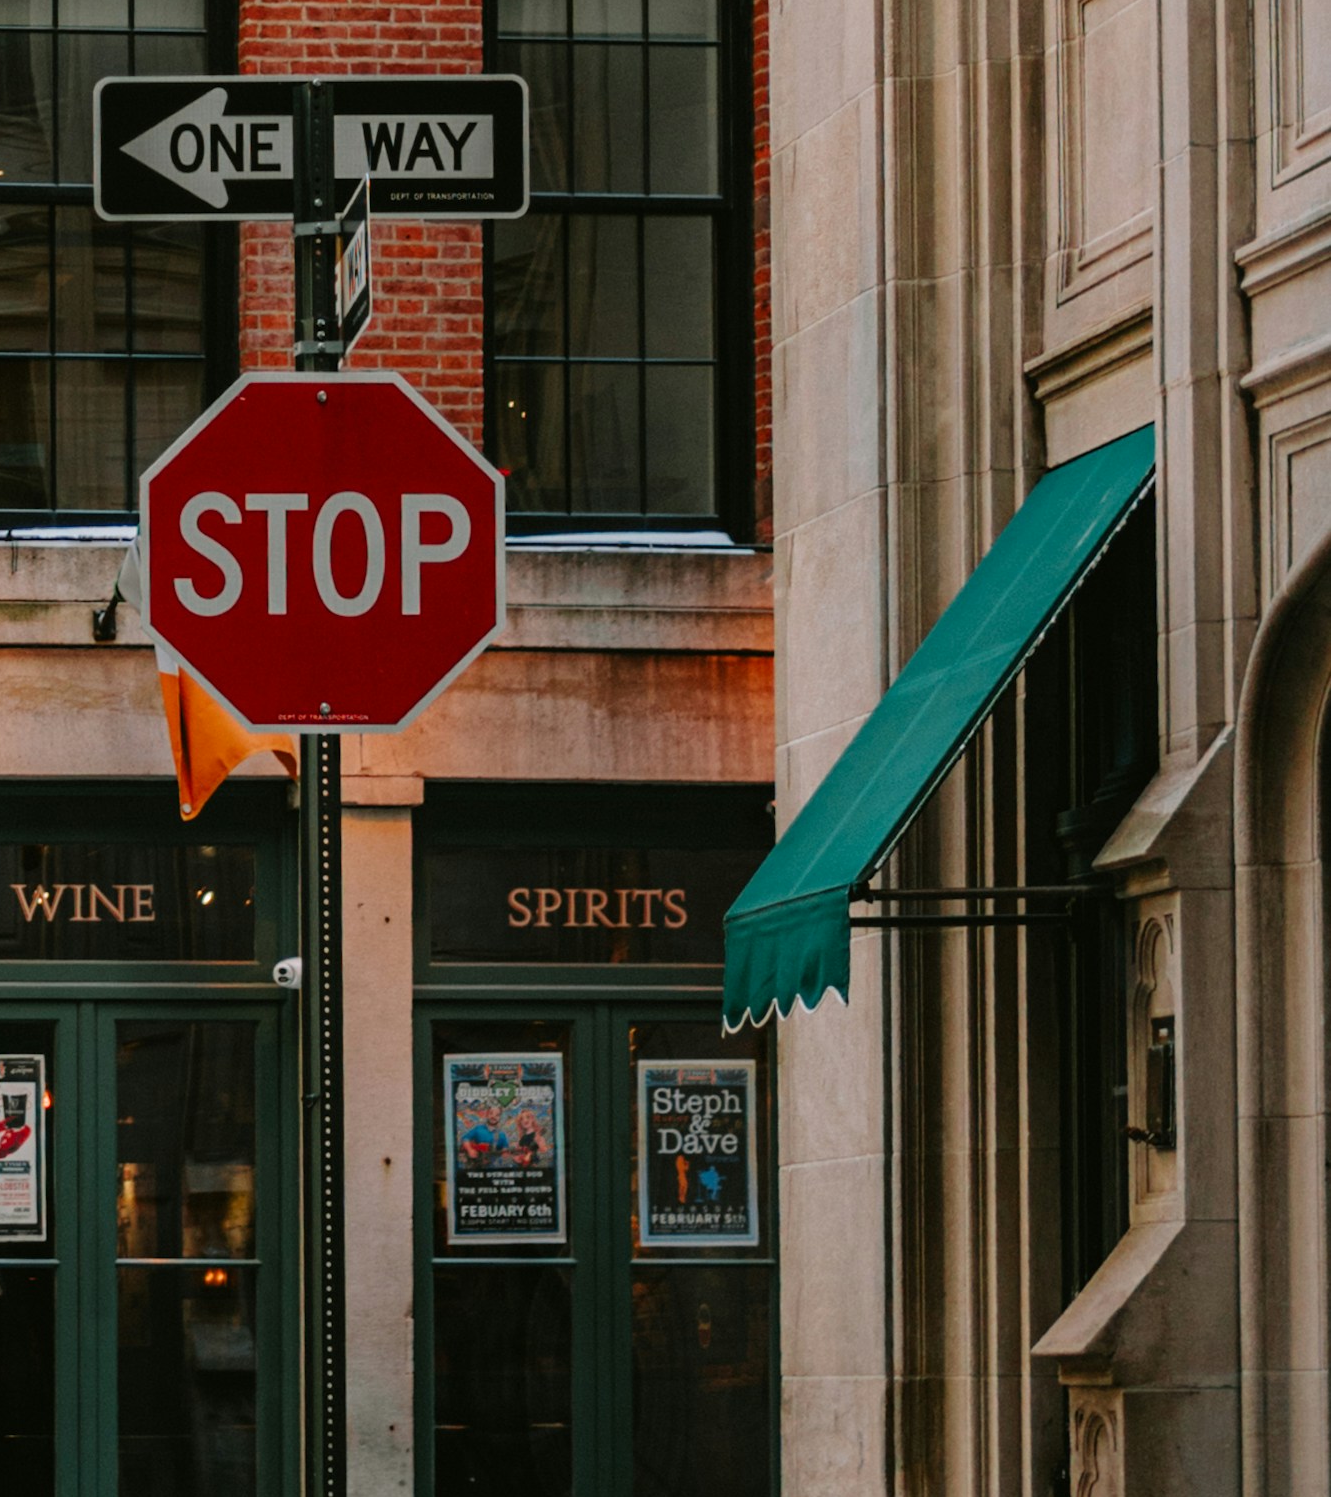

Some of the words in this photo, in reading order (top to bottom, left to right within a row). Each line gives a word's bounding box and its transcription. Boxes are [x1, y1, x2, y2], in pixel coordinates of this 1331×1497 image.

[169, 122, 282, 174] ONE
[361, 121, 479, 172] WAY
[413, 192, 424, 201] OF
[427, 192, 495, 201] TRANSPORTATION
[173, 491, 472, 617] STOP
[9, 884, 156, 922] WINE
[507, 887, 688, 928] SPIRITS
[653, 1088, 742, 1117] Steph
[689, 1114, 711, 1134] &
[657, 1129, 739, 1154] Dave
[1, 1182, 30, 1190] LOBSTER
[461, 1206, 525, 1217] FEBUARY
[527, 1204, 552, 1217] 6th
[651, 1214, 721, 1224] FEBRUARY
[723, 1213, 746, 1224] 5th
